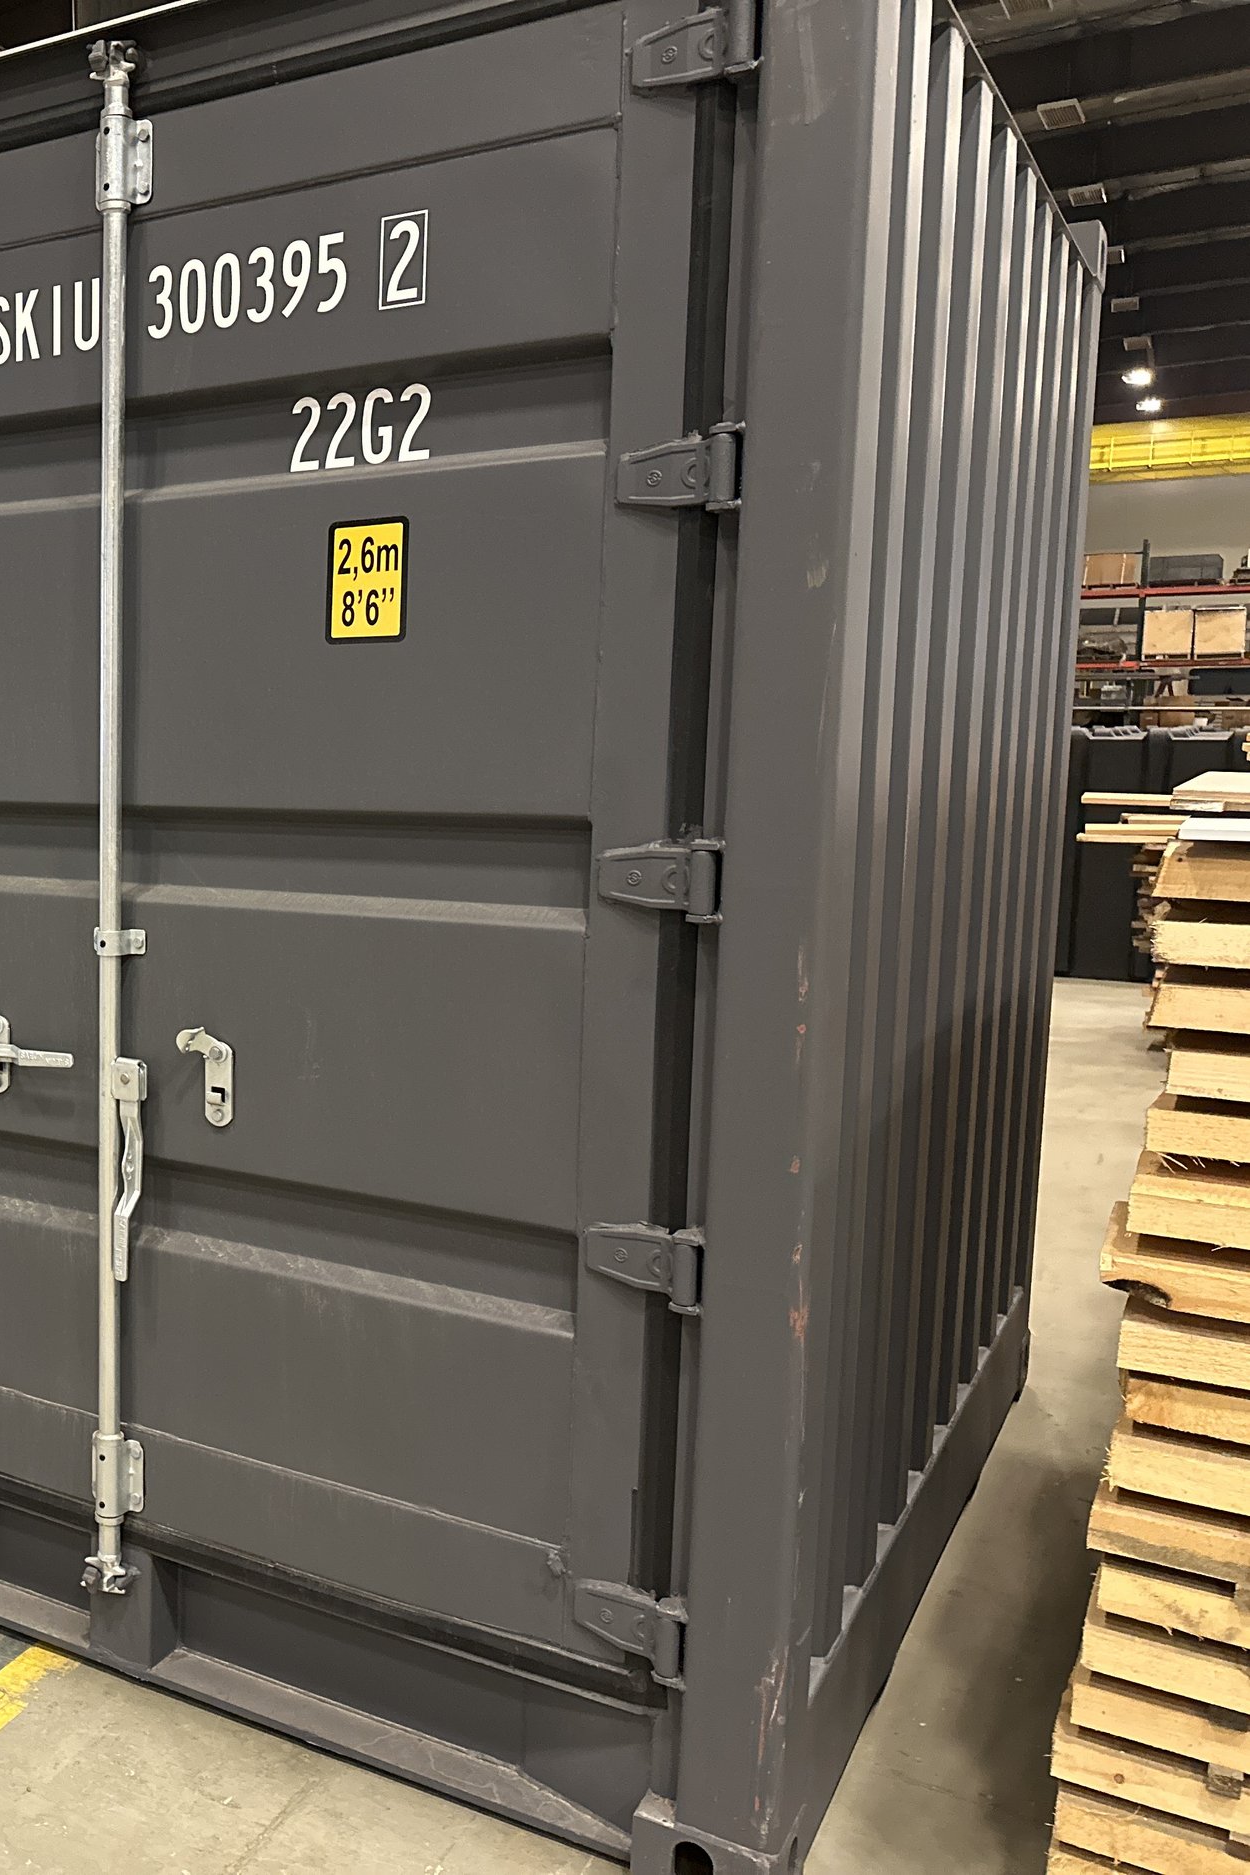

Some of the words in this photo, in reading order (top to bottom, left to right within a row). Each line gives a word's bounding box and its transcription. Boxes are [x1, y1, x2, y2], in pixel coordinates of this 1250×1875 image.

[147, 232, 348, 339] 300395
[386, 219, 421, 302] 2
[289, 383, 432, 473] 22G2
[337, 536, 400, 580] 2,6m
